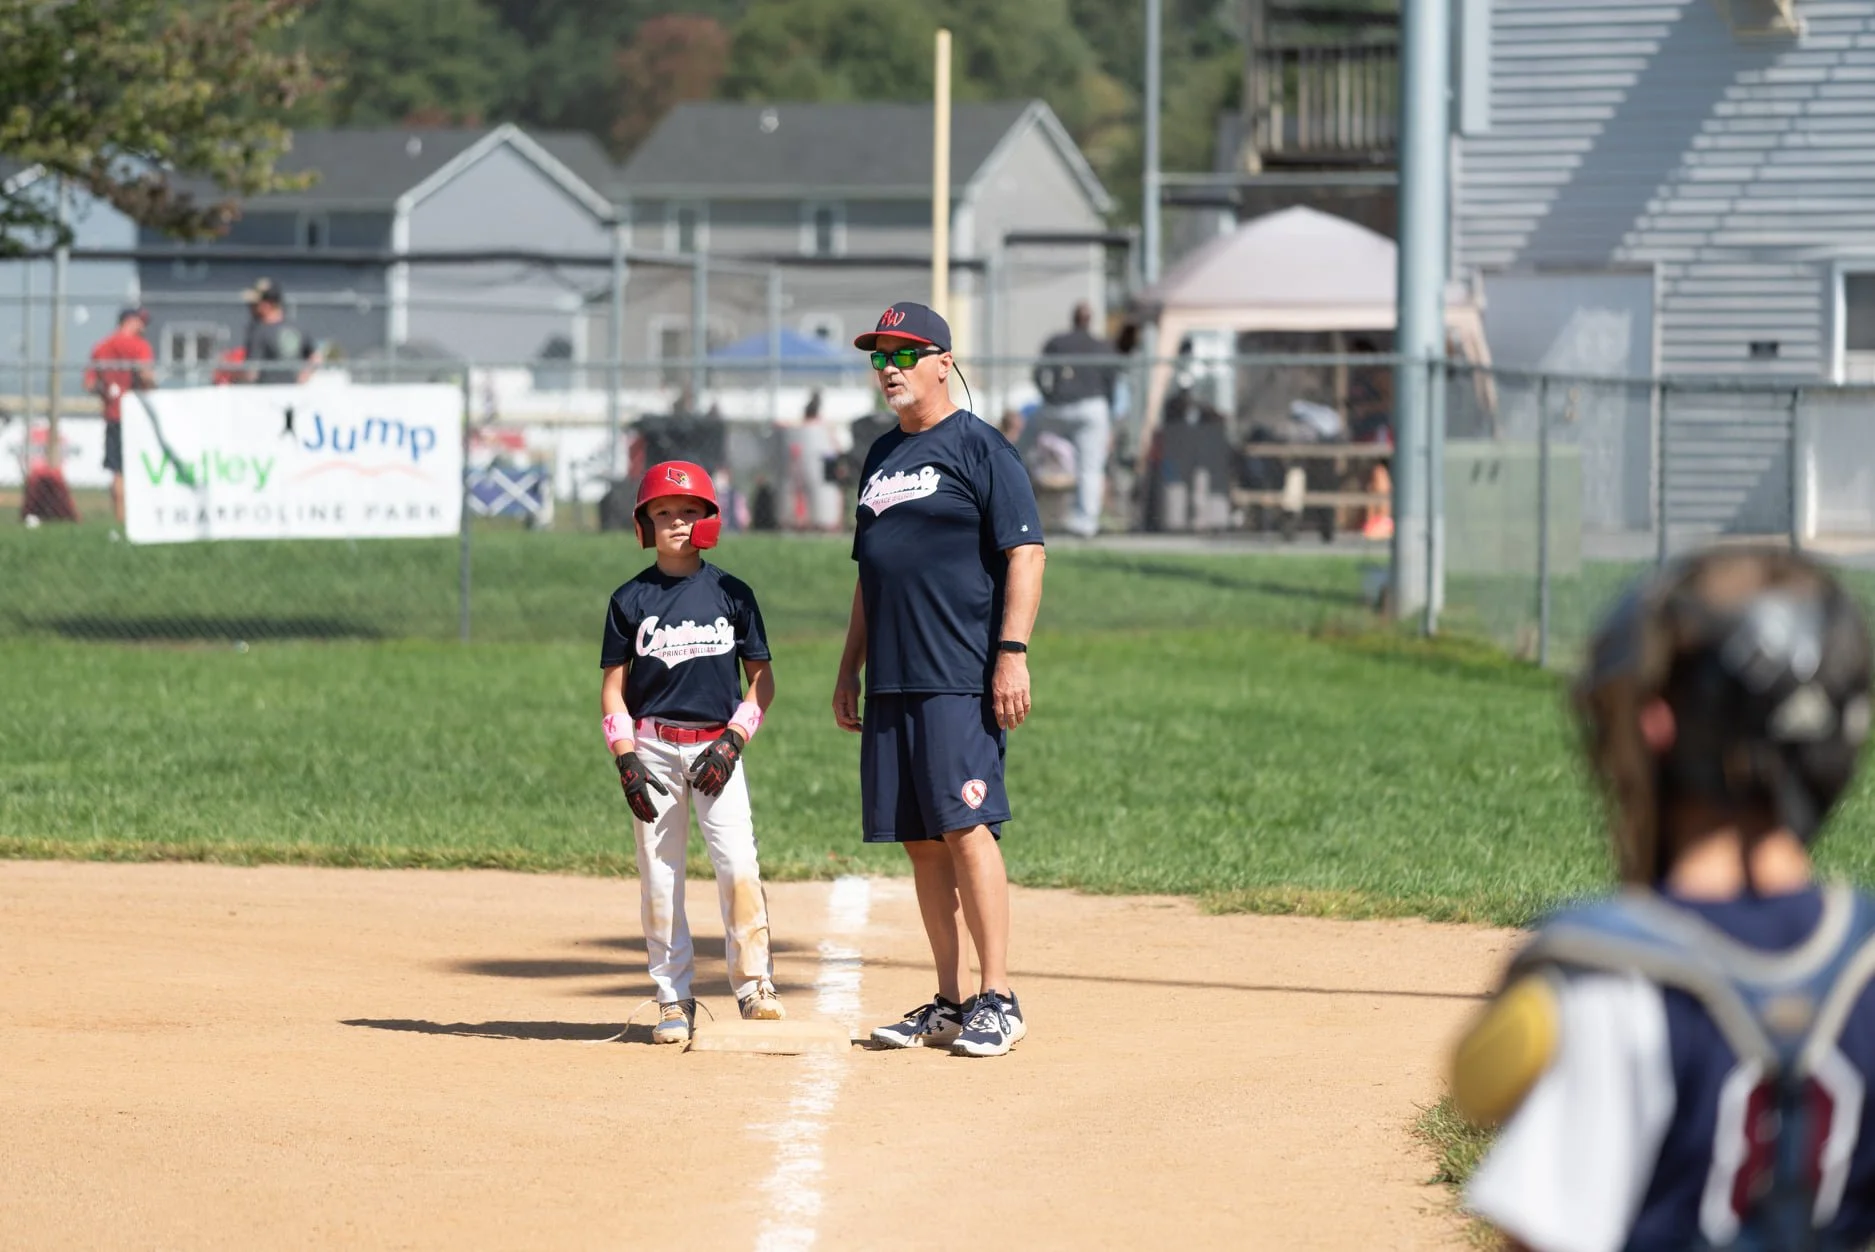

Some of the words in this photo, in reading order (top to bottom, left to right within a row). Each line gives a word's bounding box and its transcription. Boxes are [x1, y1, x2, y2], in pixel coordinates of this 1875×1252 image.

[302, 411, 438, 462] Jump
[364, 500, 443, 522] PARK
[661, 647, 687, 657] PRINCE
